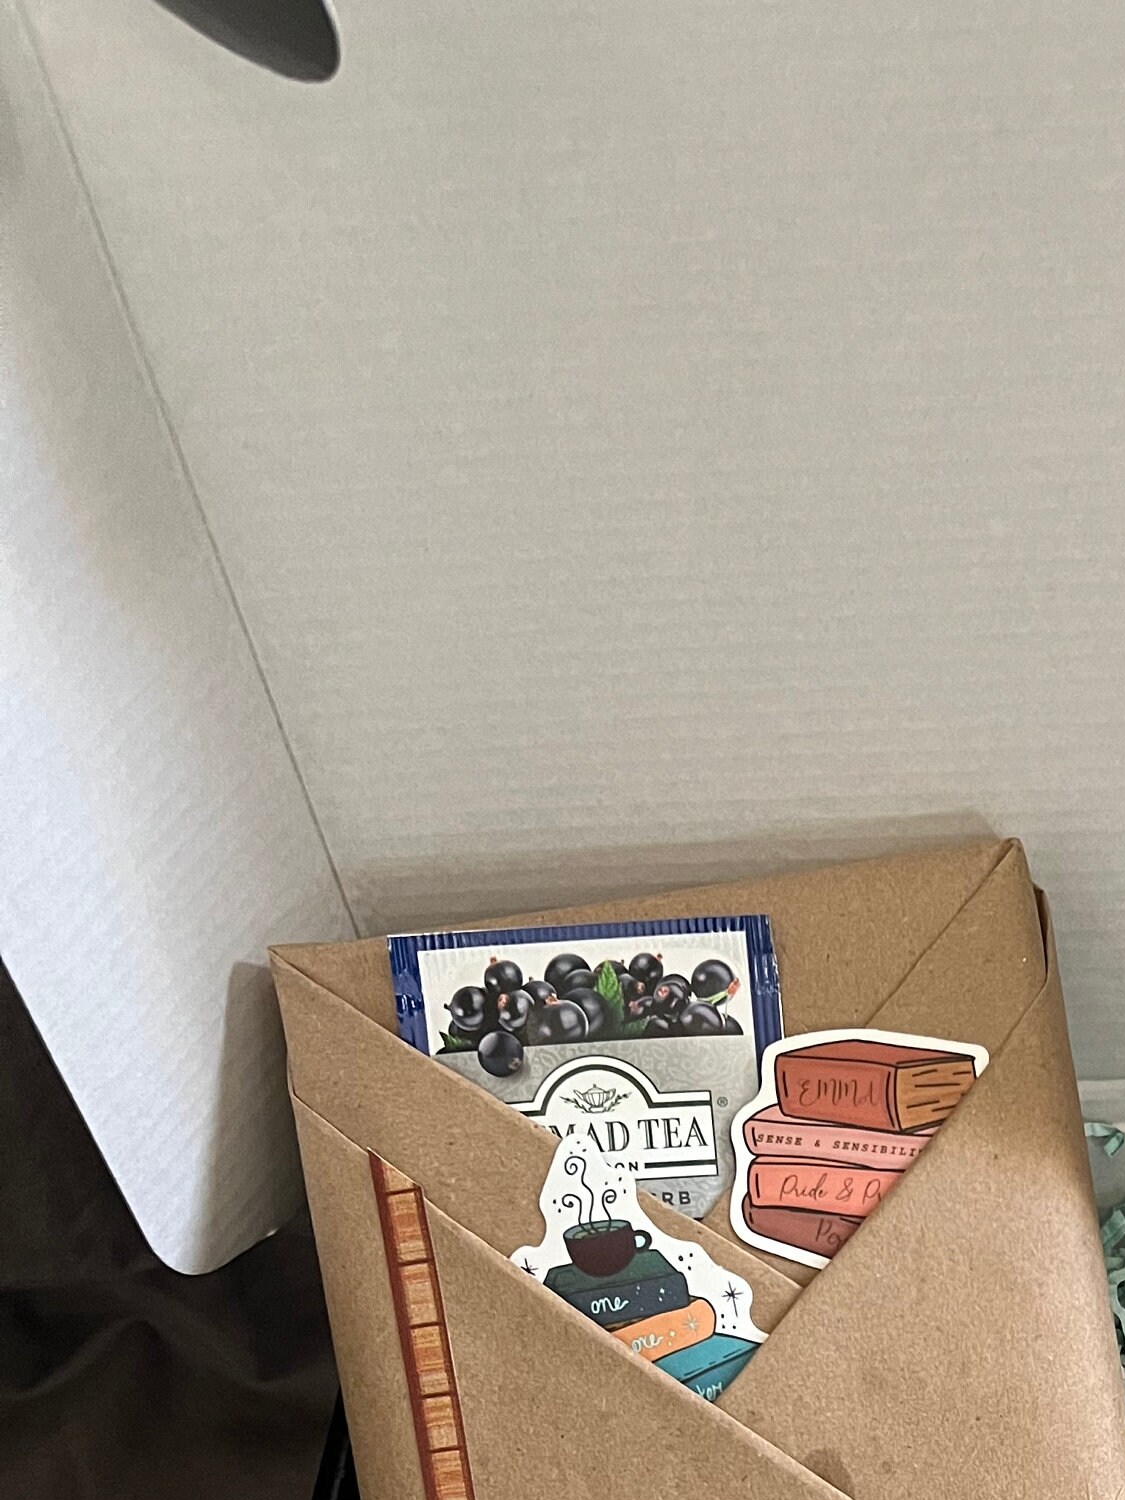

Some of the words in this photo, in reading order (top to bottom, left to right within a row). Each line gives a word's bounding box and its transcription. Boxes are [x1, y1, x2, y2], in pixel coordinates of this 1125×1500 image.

[637, 1116, 709, 1150] TEA
[756, 1134, 803, 1146] SENSE
[814, 1139, 821, 1148] &
[779, 1173, 828, 1201] Pride
[836, 1177, 854, 1202] &
[590, 1296, 630, 1314] one
